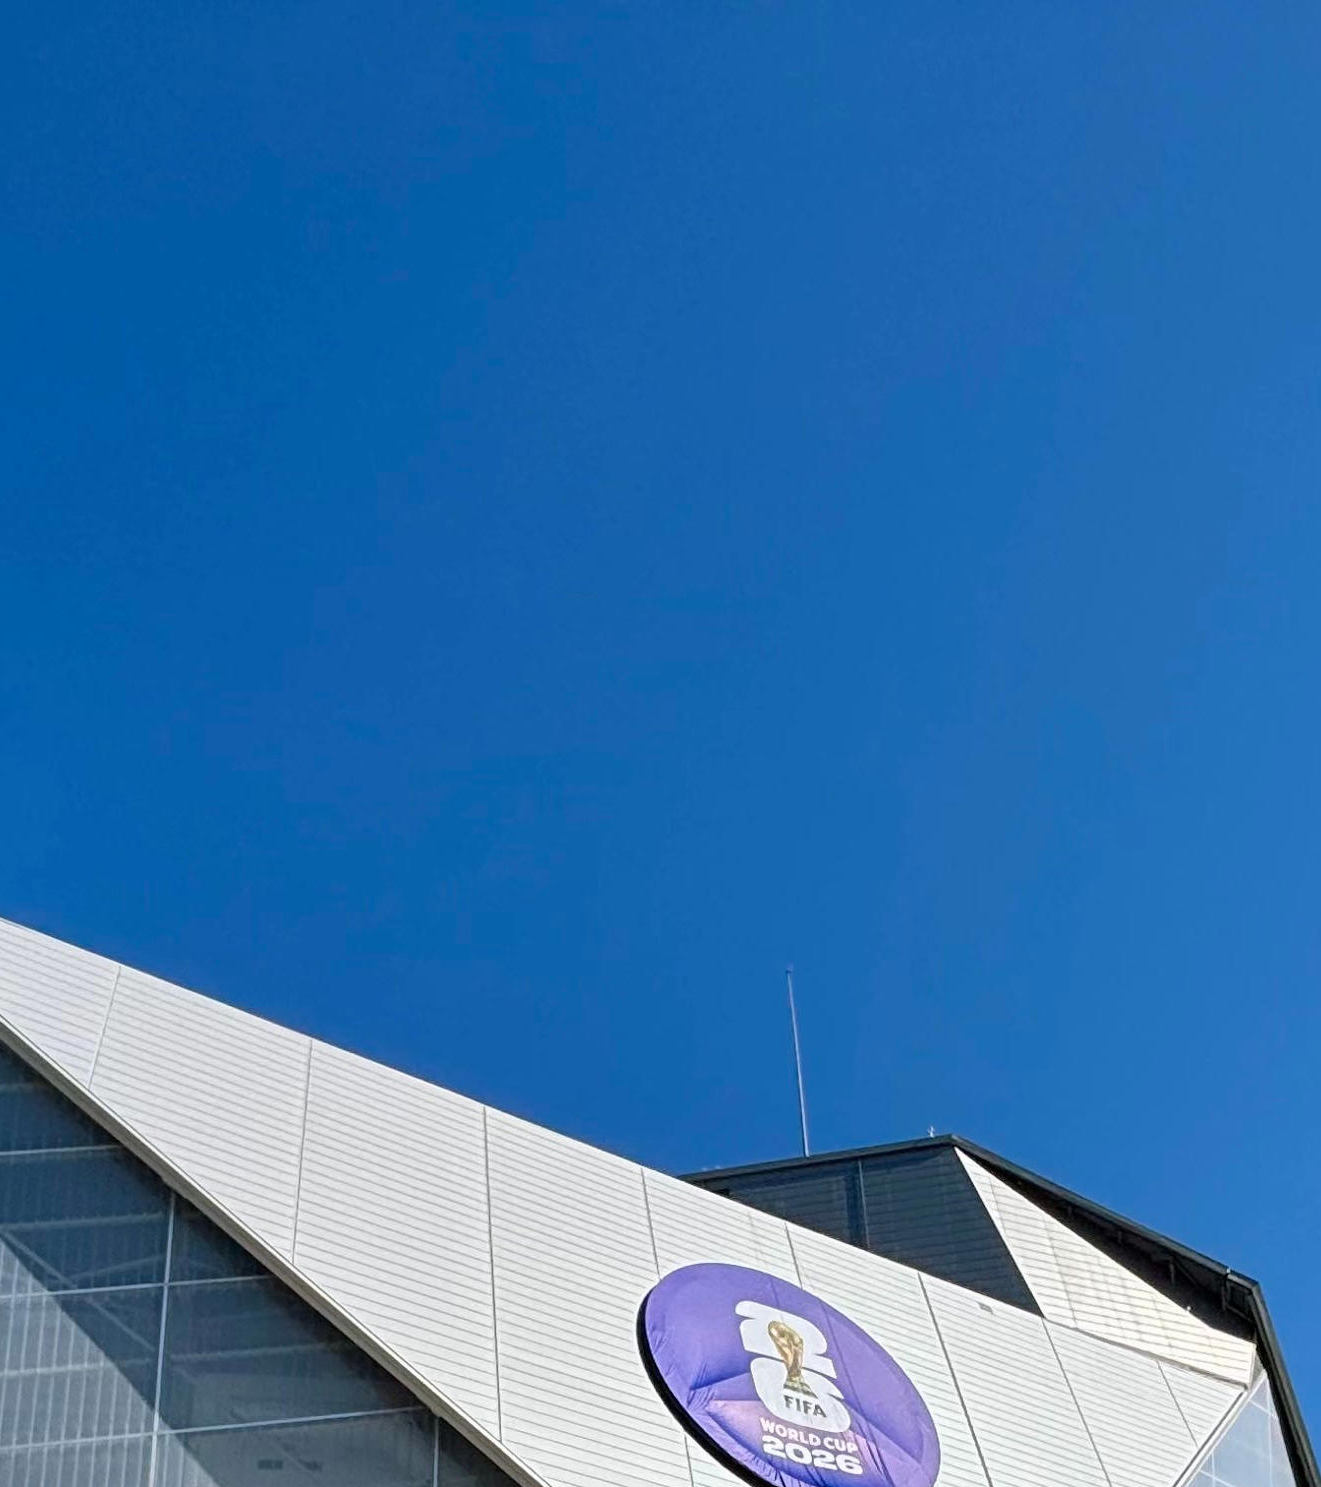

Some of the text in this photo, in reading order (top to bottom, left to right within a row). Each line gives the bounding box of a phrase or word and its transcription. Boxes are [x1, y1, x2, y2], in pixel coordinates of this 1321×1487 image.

[783, 1395, 827, 1418] FIFA
[760, 1417, 859, 1453] WORLD CUP
[762, 1435, 863, 1475] 2026
